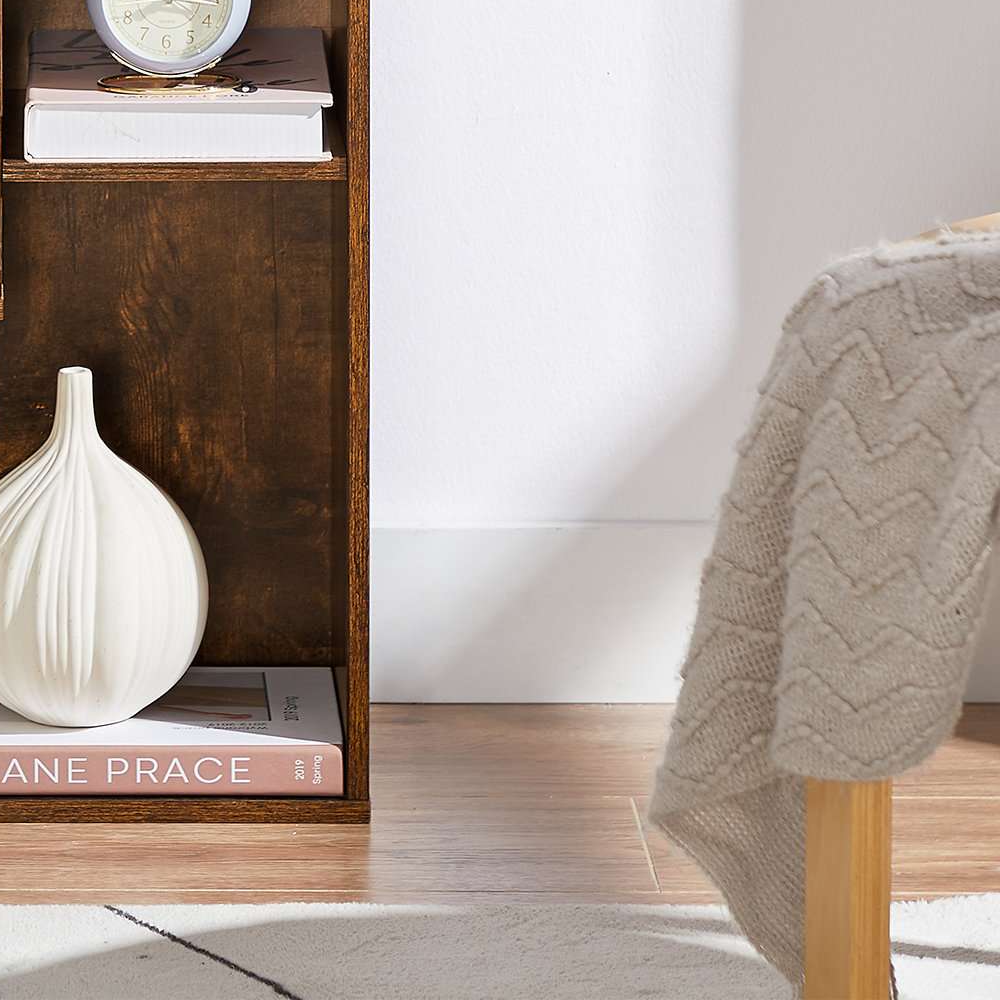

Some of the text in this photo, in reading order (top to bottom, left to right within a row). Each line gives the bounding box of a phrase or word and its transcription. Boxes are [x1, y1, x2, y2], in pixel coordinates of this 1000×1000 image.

[123, 10, 133, 25] 8
[202, 14, 212, 28] 4
[140, 26, 149, 41] 7
[186, 30, 195, 44] 5
[161, 34, 171, 49] 6
[106, 756, 252, 784] PRACE
[294, 759, 305, 780] 2019
[312, 755, 323, 785] Spring
